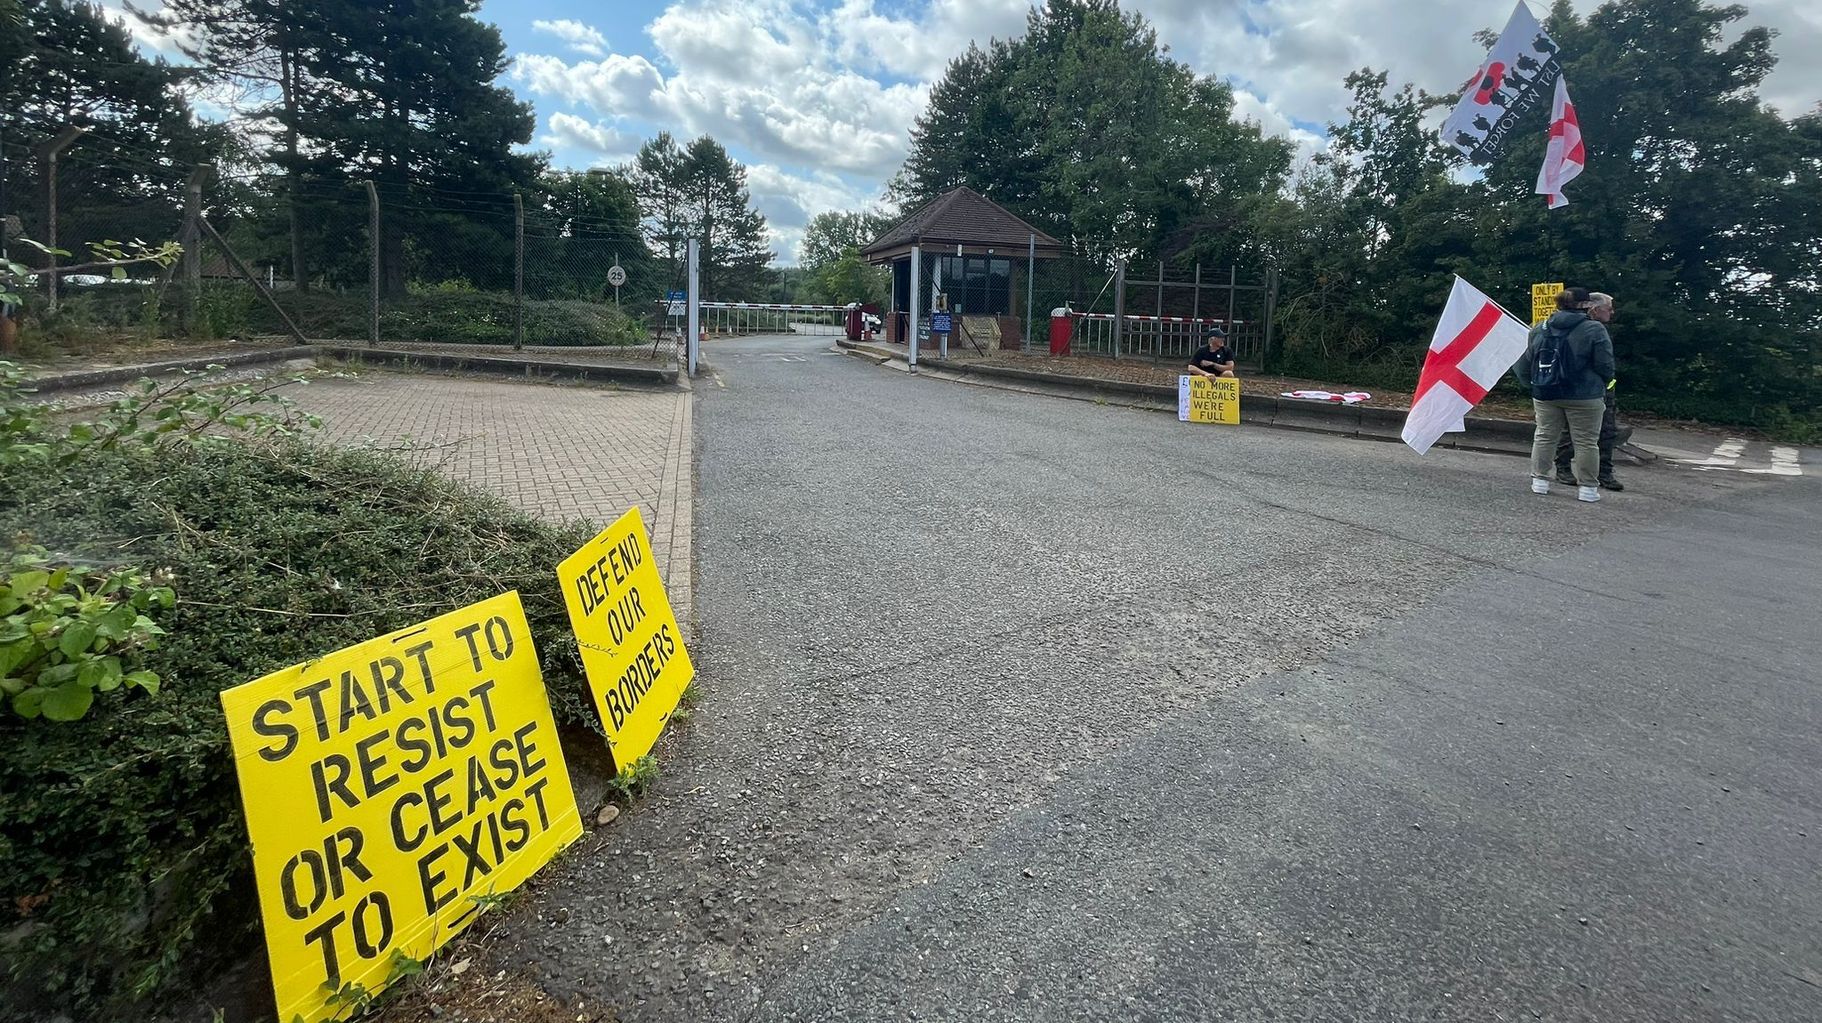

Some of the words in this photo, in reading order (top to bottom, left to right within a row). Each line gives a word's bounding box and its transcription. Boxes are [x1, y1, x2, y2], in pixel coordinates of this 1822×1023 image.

[611, 271, 623, 280] 25
[1535, 285, 1551, 295] ONLY
[1534, 296, 1556, 306] STANDI
[1534, 306, 1554, 317] TOGET
[1192, 390, 1236, 401] ILLEGALS
[1194, 380, 1205, 388] NO
[1211, 381, 1236, 391] MORE
[1200, 411, 1225, 421] FULL
[576, 533, 642, 617] DEFEND
[607, 587, 646, 646] OUR
[252, 641, 434, 762] START
[455, 616, 514, 672] TO
[605, 624, 675, 732] BORDERS
[311, 680, 498, 823] RESIST
[280, 827, 373, 920] OR
[390, 721, 547, 852] CEASE
[305, 891, 393, 987] TO
[417, 778, 549, 917] EXIST
